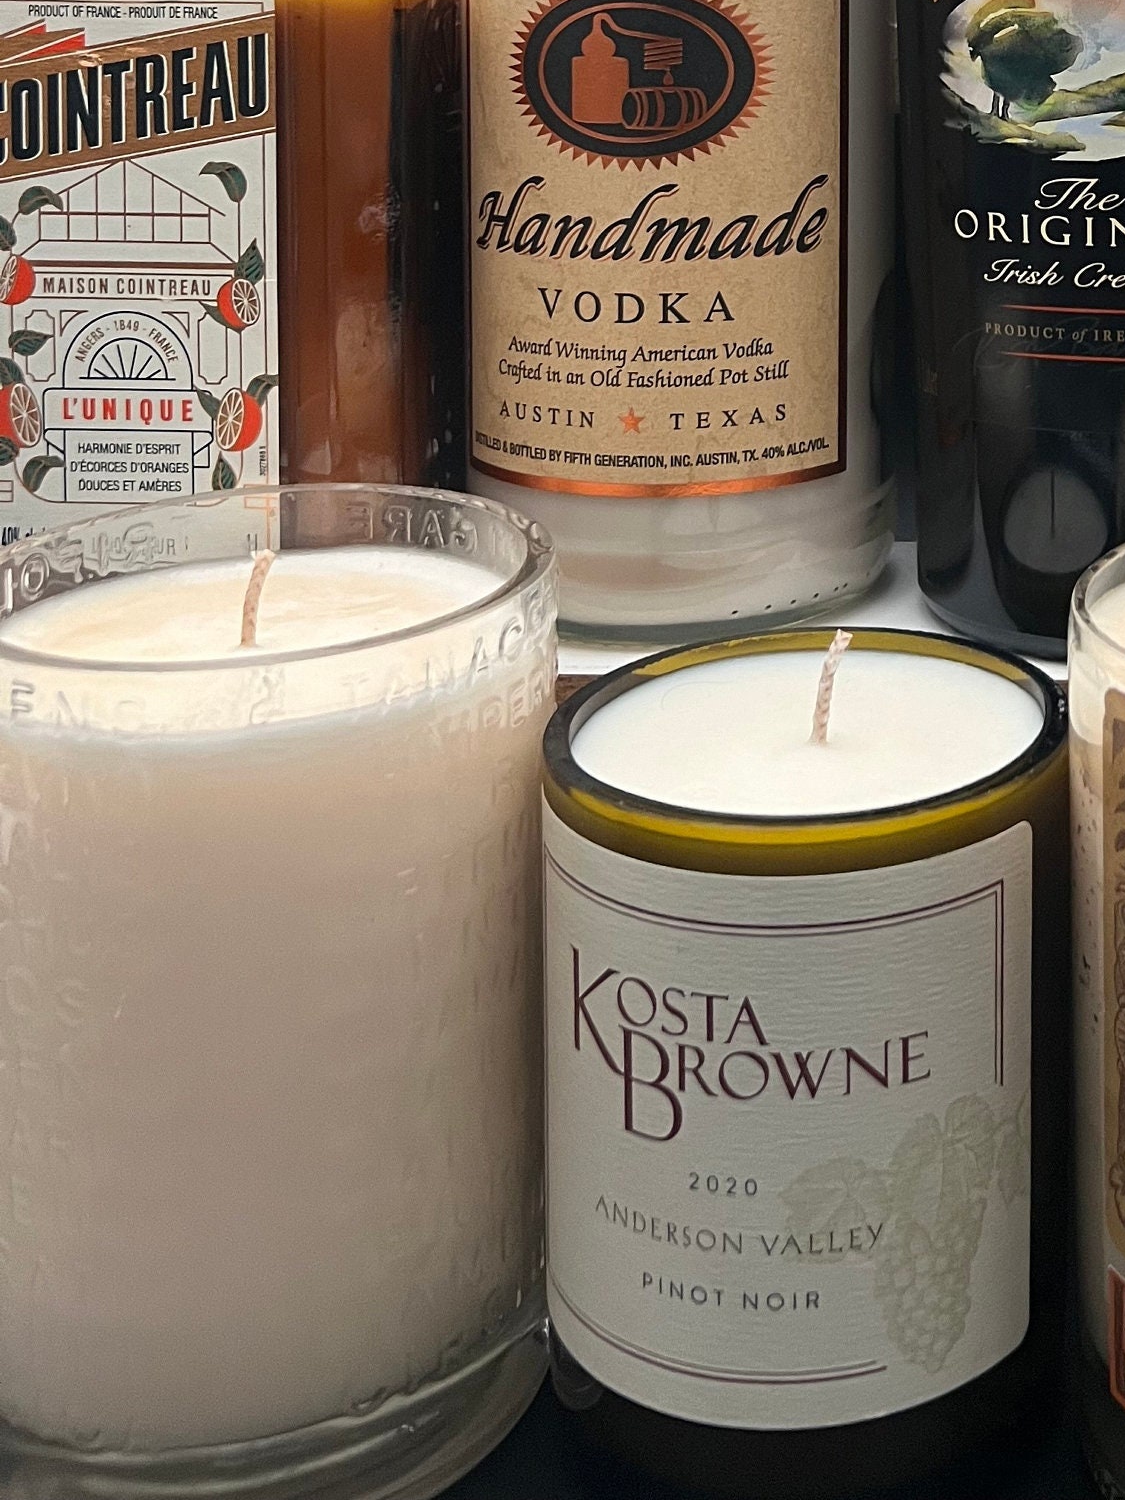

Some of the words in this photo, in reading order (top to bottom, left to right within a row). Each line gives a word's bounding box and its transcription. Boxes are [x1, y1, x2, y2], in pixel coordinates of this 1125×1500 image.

[28, 5, 70, 18] PRODUCT
[72, 5, 84, 17] OF
[86, 6, 122, 18] FRANCE
[129, 6, 166, 19] PRODUIT
[169, 7, 181, 19] DE
[183, 7, 218, 19] FRANCE
[0, 33, 269, 165] OINTREAU
[476, 174, 829, 264] Handmade
[43, 277, 108, 294] MAISON
[117, 278, 211, 295] COINTREAU
[983, 259, 1064, 287] Irish
[537, 287, 735, 324] VODKA
[113, 319, 140, 332] 1849
[985, 322, 1065, 341] PRODUCT
[508, 336, 552, 356] Award
[555, 340, 627, 368] Winning
[632, 345, 719, 363] American
[723, 338, 773, 360] Vodka
[499, 359, 542, 384] Crafted
[546, 369, 562, 384] in
[566, 373, 585, 385] an
[590, 367, 622, 388] Old
[627, 368, 714, 389] Fashioned
[719, 369, 749, 386] Pot
[754, 360, 790, 381] Still
[62, 397, 194, 426] L'UNIQUE
[499, 400, 595, 428] AUSTIN
[670, 403, 787, 430] TEXAS
[78, 443, 132, 454] HARMONIE
[136, 443, 181, 455] D'ESPRIT
[510, 442, 547, 460] BOTTLED
[564, 451, 592, 465] FIFTH
[595, 453, 667, 469] GENERATION,
[670, 454, 694, 468] INC.
[696, 451, 741, 467] AUSTIN,
[70, 458, 127, 473] D'ÉCORCES
[130, 461, 189, 474] D'ORANGES
[78, 479, 120, 492] DOUCES
[123, 480, 135, 491] ET
[138, 477, 182, 492] AMÈRES
[570, 943, 770, 1077] KOSTA
[618, 1023, 932, 1142] BROWNE
[689, 1172, 758, 1197] 2020
[595, 1194, 743, 1255] ANDERSON
[760, 1222, 884, 1257] VALLEY
[642, 1271, 724, 1306] PINOT
[742, 1290, 821, 1311] NOIR
